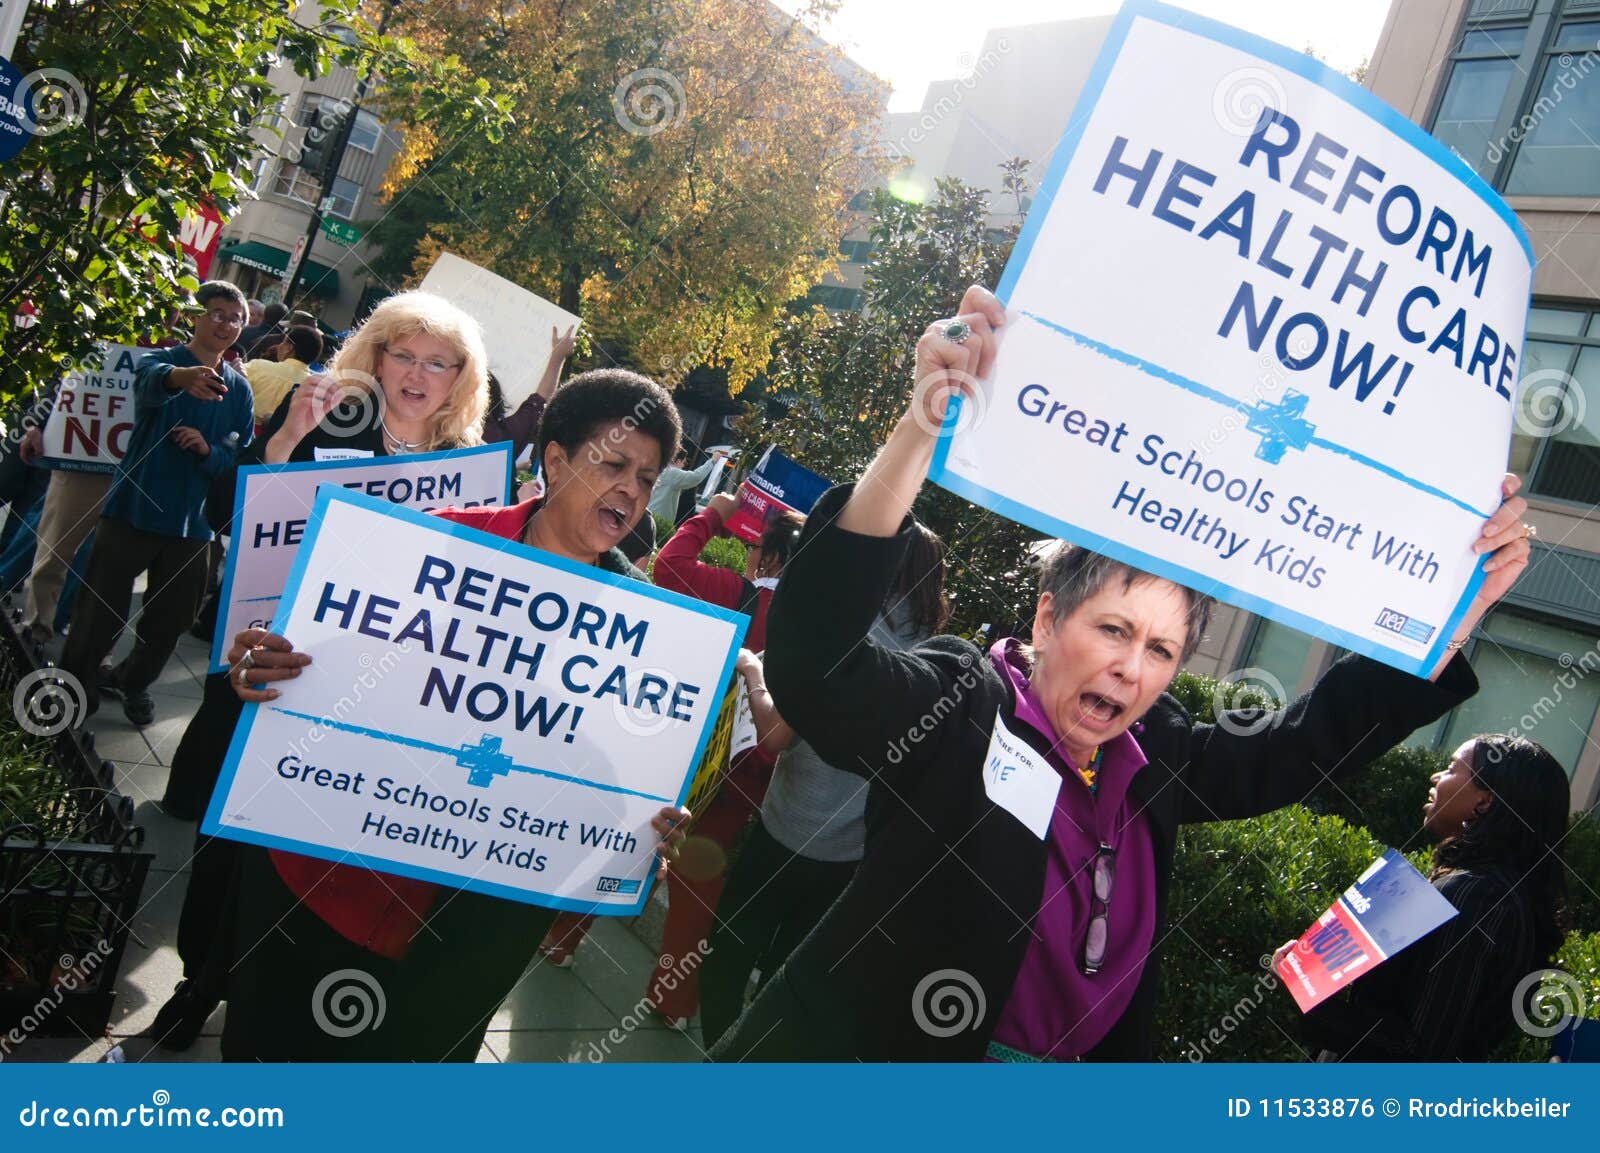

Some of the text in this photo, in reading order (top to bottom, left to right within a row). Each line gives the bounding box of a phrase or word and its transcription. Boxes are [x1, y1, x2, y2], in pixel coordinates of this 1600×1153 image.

[331, 222, 340, 234] K
[1238, 105, 1494, 298] REFORM
[232, 254, 273, 273] STARBUCKS
[1092, 136, 1518, 402] HEALTH CARE
[84, 375, 129, 391] INSU
[1217, 281, 1415, 416] NOW!
[58, 390, 127, 418] REF
[1017, 384, 1441, 583] Great Schools Start With
[1112, 480, 1328, 589] Healthy Kids
[413, 555, 650, 657] REFORM
[1376, 610, 1408, 633] nea
[313, 582, 547, 681] HEALTH
[561, 653, 701, 723] CARE
[419, 667, 584, 744] NOW!
[277, 755, 637, 854] Great Schools Start With
[361, 812, 548, 873] Healthy Kids
[1308, 917, 1370, 982] NOW!
